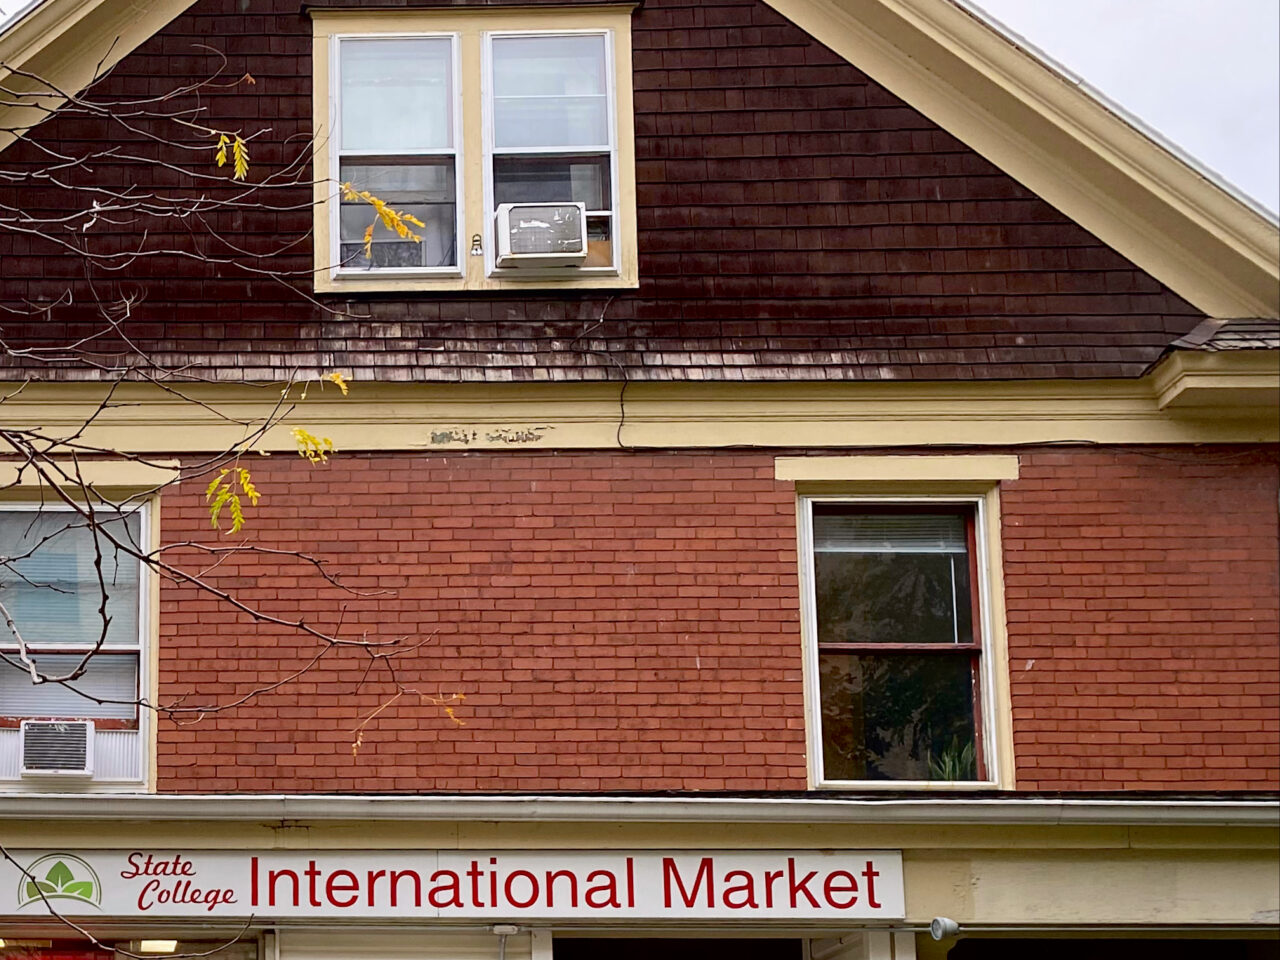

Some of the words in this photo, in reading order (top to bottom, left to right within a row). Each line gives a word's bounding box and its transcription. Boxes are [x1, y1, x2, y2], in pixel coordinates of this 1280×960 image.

[120, 851, 197, 879] State
[137, 879, 238, 912] College
[250, 856, 636, 909] International
[662, 856, 882, 910] Market
